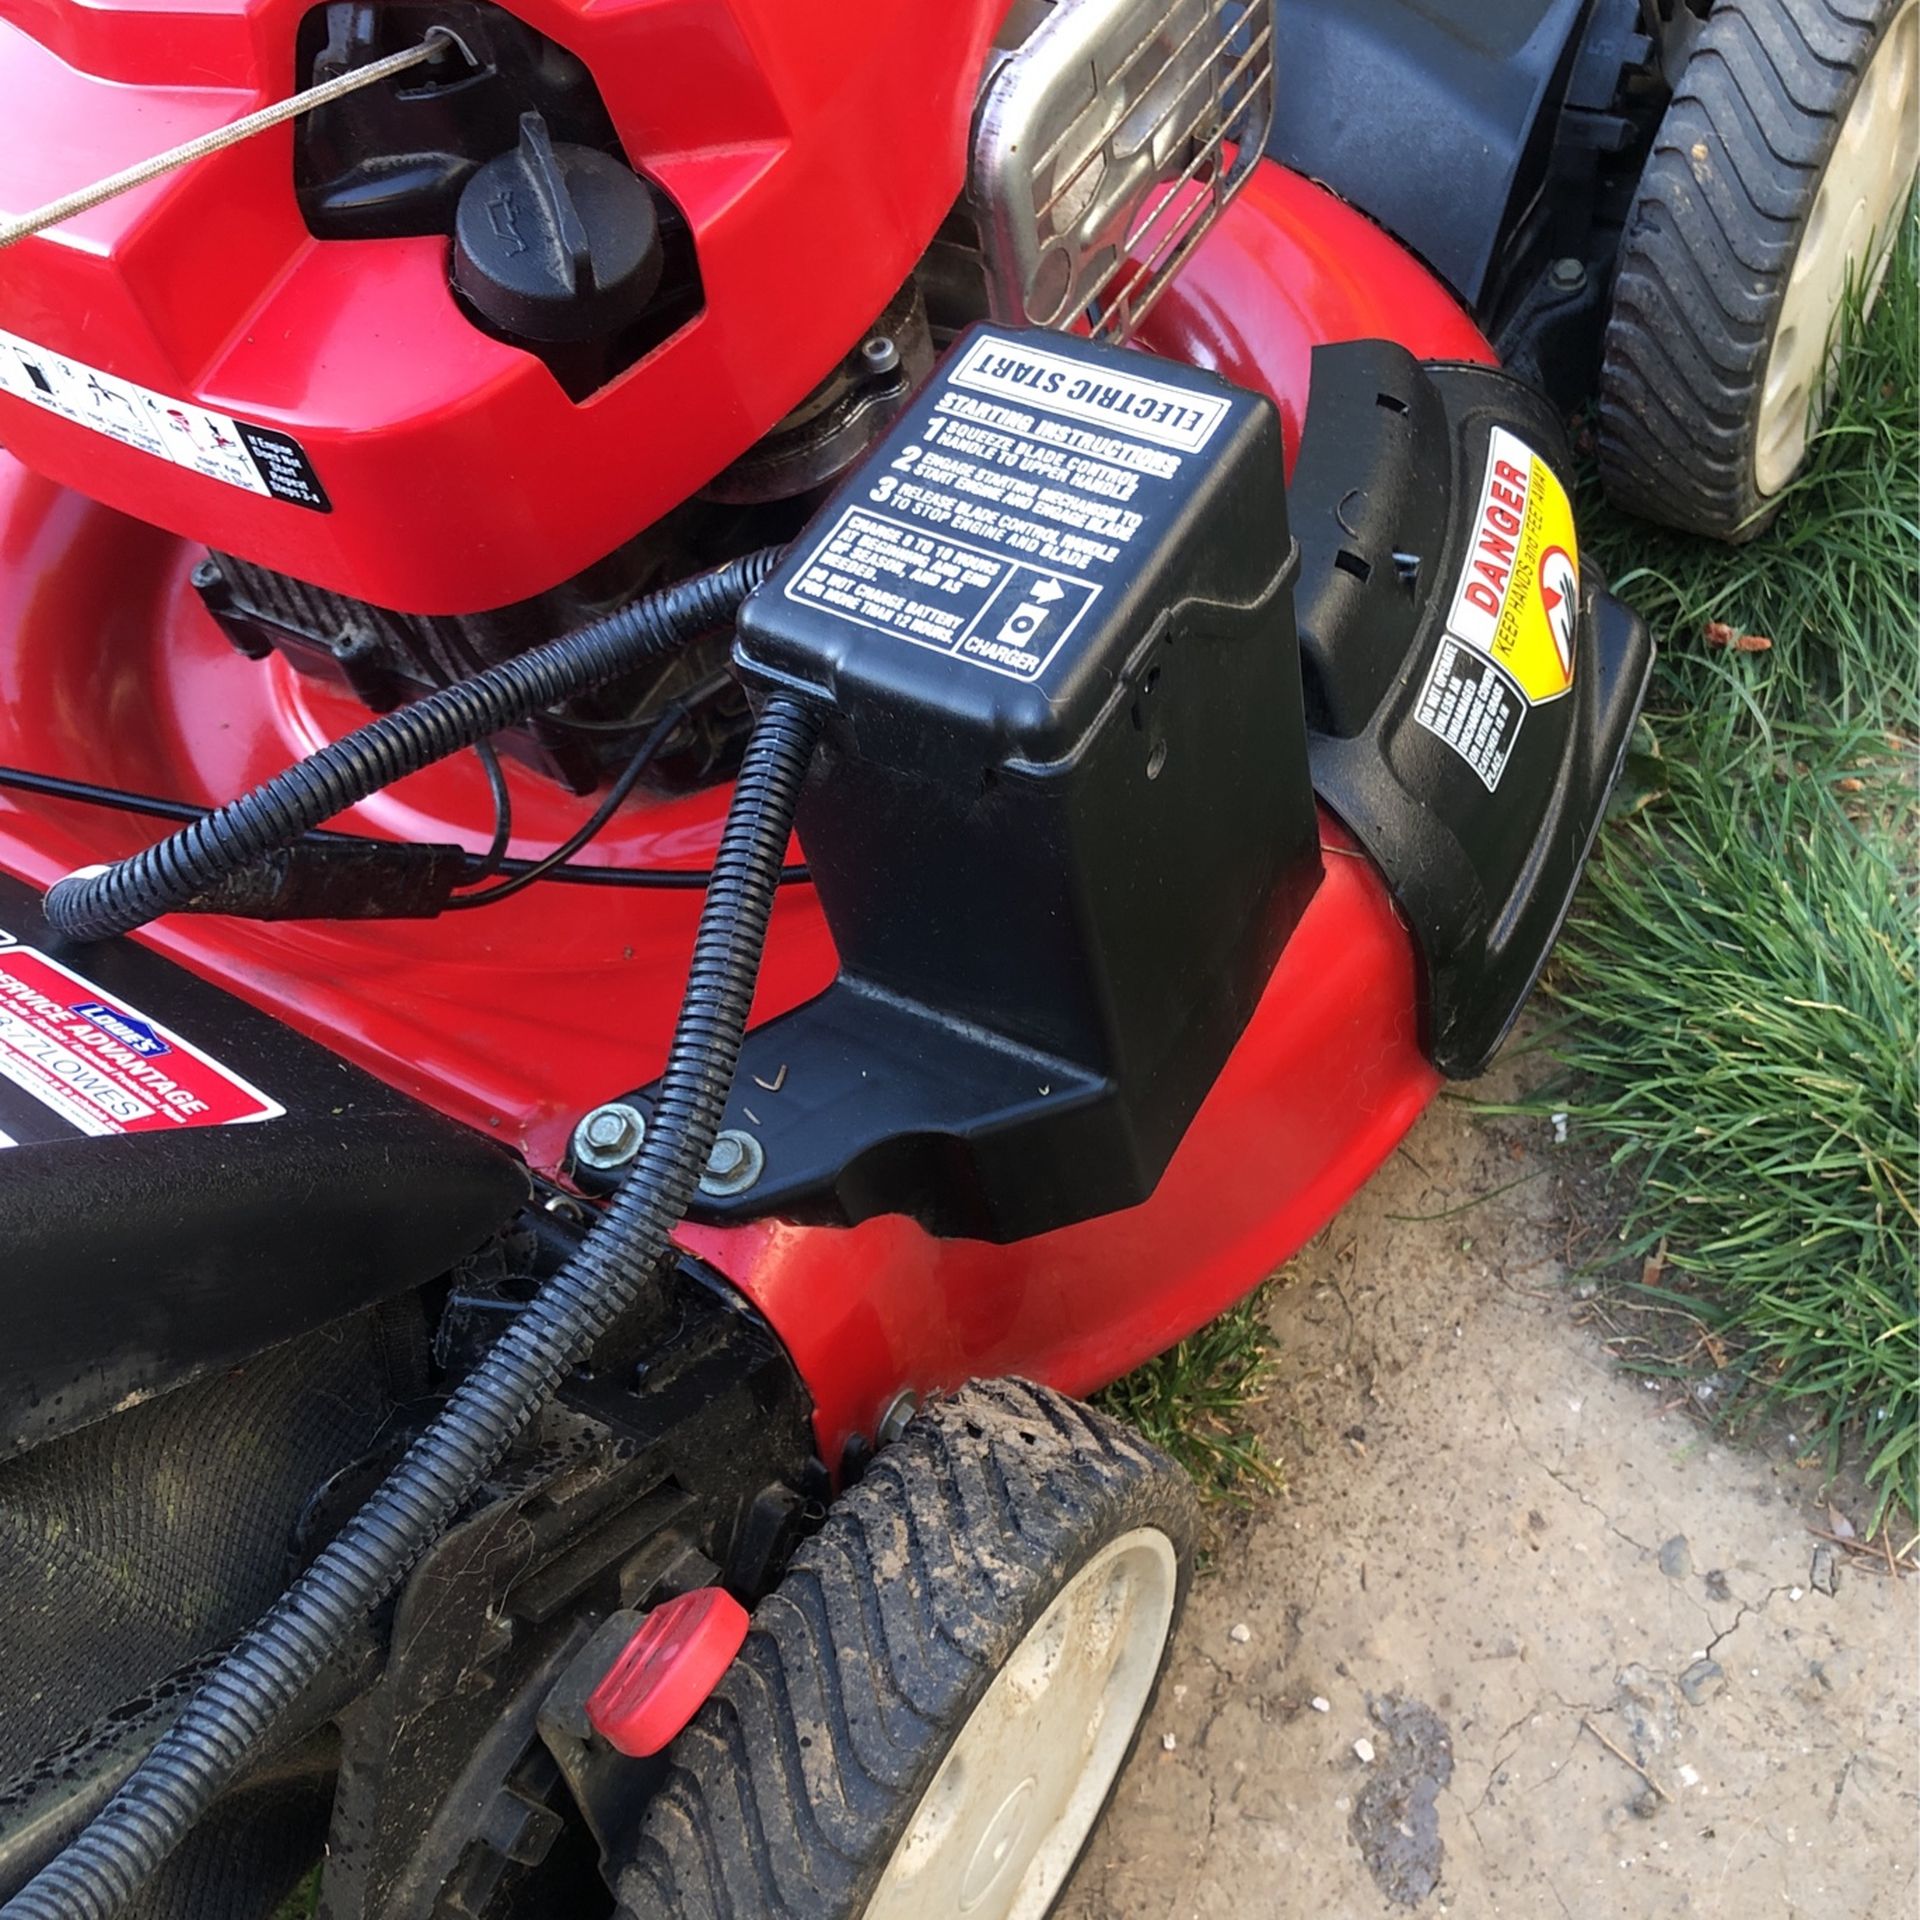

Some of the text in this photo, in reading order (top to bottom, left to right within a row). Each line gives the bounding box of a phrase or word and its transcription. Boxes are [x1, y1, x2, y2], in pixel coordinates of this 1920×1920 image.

[972, 352, 1204, 432] ELECTRIC START
[889, 443, 924, 472] 2
[917, 414, 948, 442] 1
[936, 390, 1184, 475] STARTING INSTRUCTIONS
[943, 420, 1141, 488] SQUEEZE BLADE CONTROL
[268, 461, 298, 478] Start
[269, 471, 309, 491] Repeat
[281, 455, 302, 469] Not
[866, 474, 900, 503] 3
[920, 451, 977, 478] ENGAGE
[972, 467, 1041, 498] STARTING
[1117, 512, 1144, 529] TO
[934, 432, 1135, 501] HANDLE TO UPPER HANDLE
[888, 494, 1092, 569] TO STOP ENGINE AND BLADE
[897, 482, 958, 511] RELEASE
[953, 500, 1001, 524] BLADE
[995, 513, 1063, 544] CONTROL
[912, 463, 957, 485] START
[953, 476, 1006, 501] ENGINE
[1001, 491, 1035, 510] AND
[1082, 516, 1136, 541] BLADE
[1525, 499, 1545, 535] FEET
[827, 539, 852, 556] OF
[938, 577, 964, 594] AS
[836, 528, 860, 544] AT
[929, 558, 962, 578] AND
[845, 516, 904, 543] CHARGE
[911, 537, 935, 554] TO
[951, 550, 1002, 576] HOURS
[1466, 460, 1527, 618] DANGER
[1520, 535, 1538, 563] and
[902, 600, 965, 630] BATTERY
[1507, 560, 1533, 615] HANDS
[891, 611, 913, 627] 12
[1496, 609, 1519, 655] KEEP
[961, 635, 1040, 673] CHARGER
[1420, 643, 1458, 727] DO NOT OPERATE
[1433, 676, 1462, 734] UNLESS AN
[1447, 679, 1476, 742] UNDAMAGED
[1458, 668, 1495, 753] DISCHARGE COVER
[1469, 745, 1480, 763] OR
[1487, 683, 1504, 716] GRASS
[1478, 704, 1509, 774] CATCHER IS IN
[0, 969, 77, 1023] ERVICE
[63, 1021, 209, 1115] ADVANTAGE
